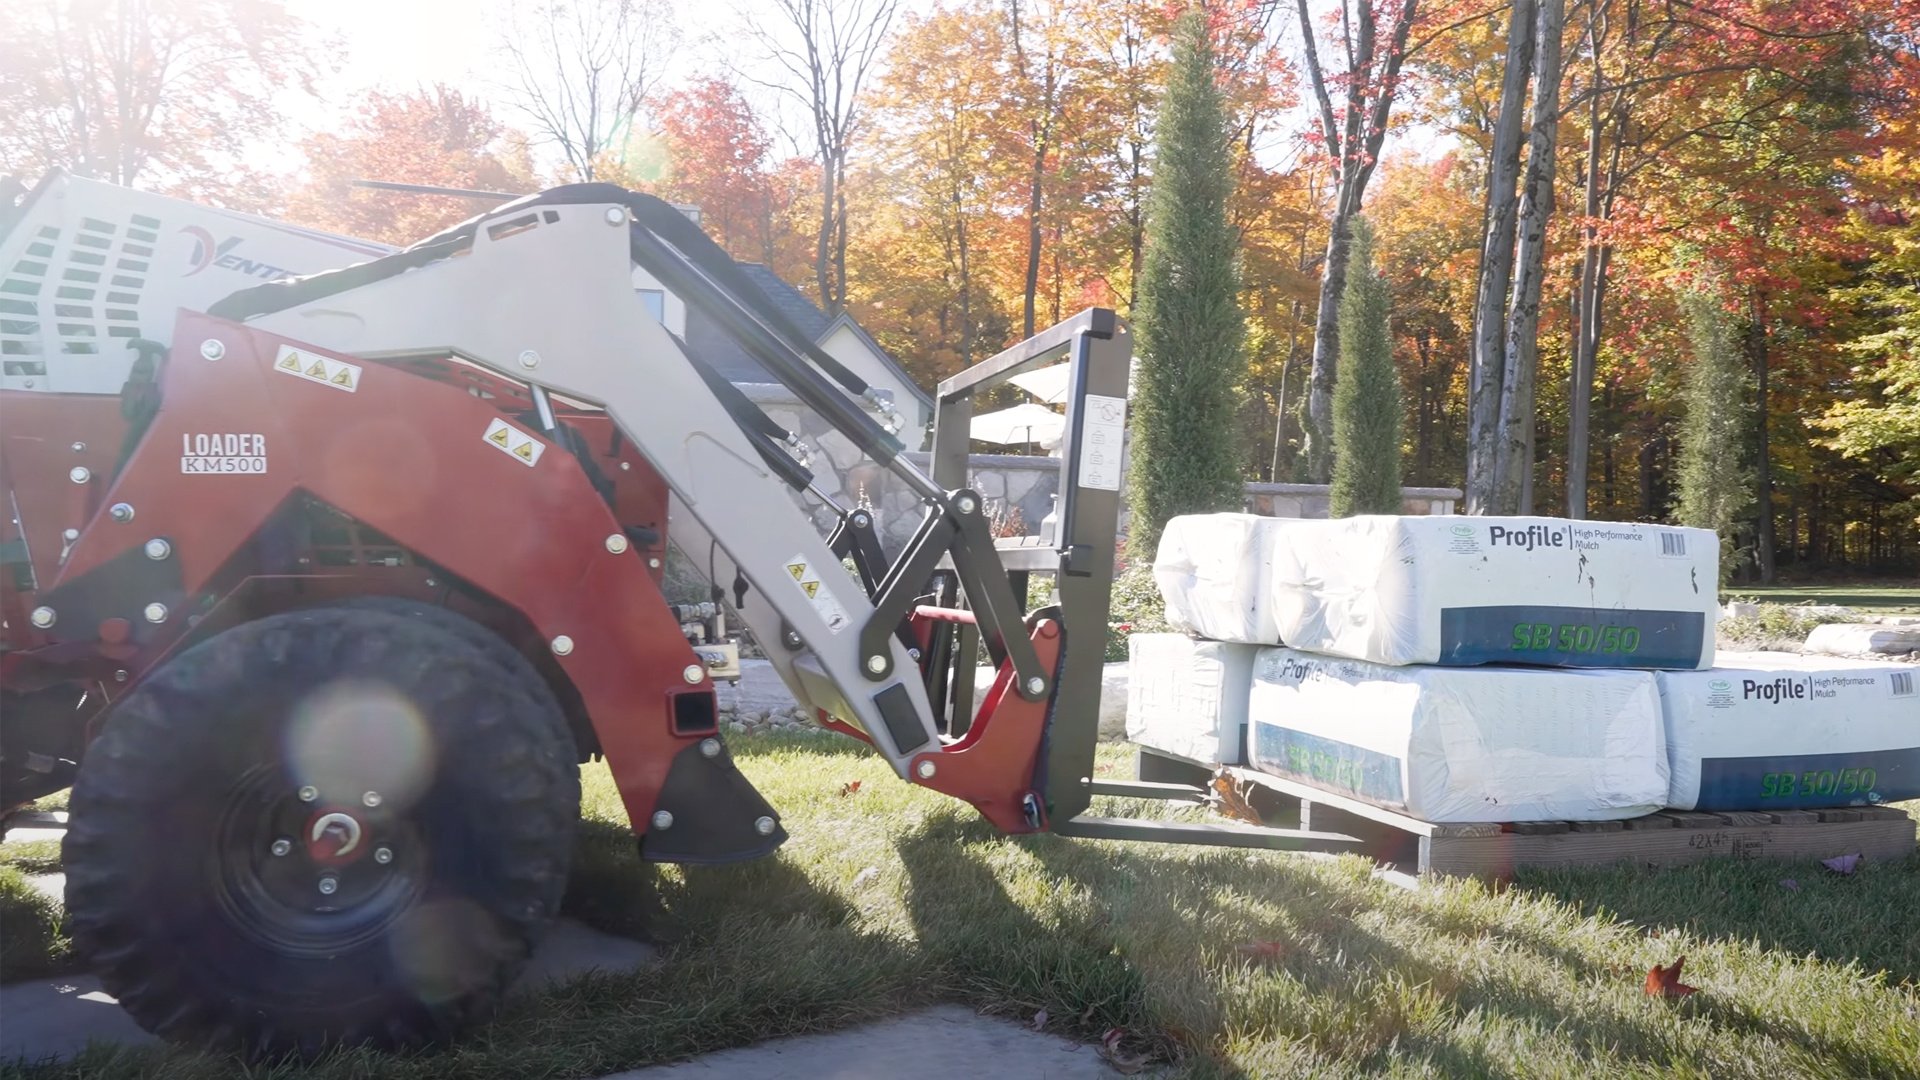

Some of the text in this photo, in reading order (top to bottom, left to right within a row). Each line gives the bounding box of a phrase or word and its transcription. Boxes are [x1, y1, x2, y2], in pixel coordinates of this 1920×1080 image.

[183, 433, 266, 456] LOADER
[184, 458, 263, 472] KM500
[1574, 529, 1643, 541] High Performance
[1575, 540, 1600, 550] Mulch
[1511, 623, 1640, 653] SB 50/50
[1814, 676, 1875, 687] High Performance
[1814, 689, 1837, 698] Mulch
[1760, 768, 1877, 798] SB 50/50
